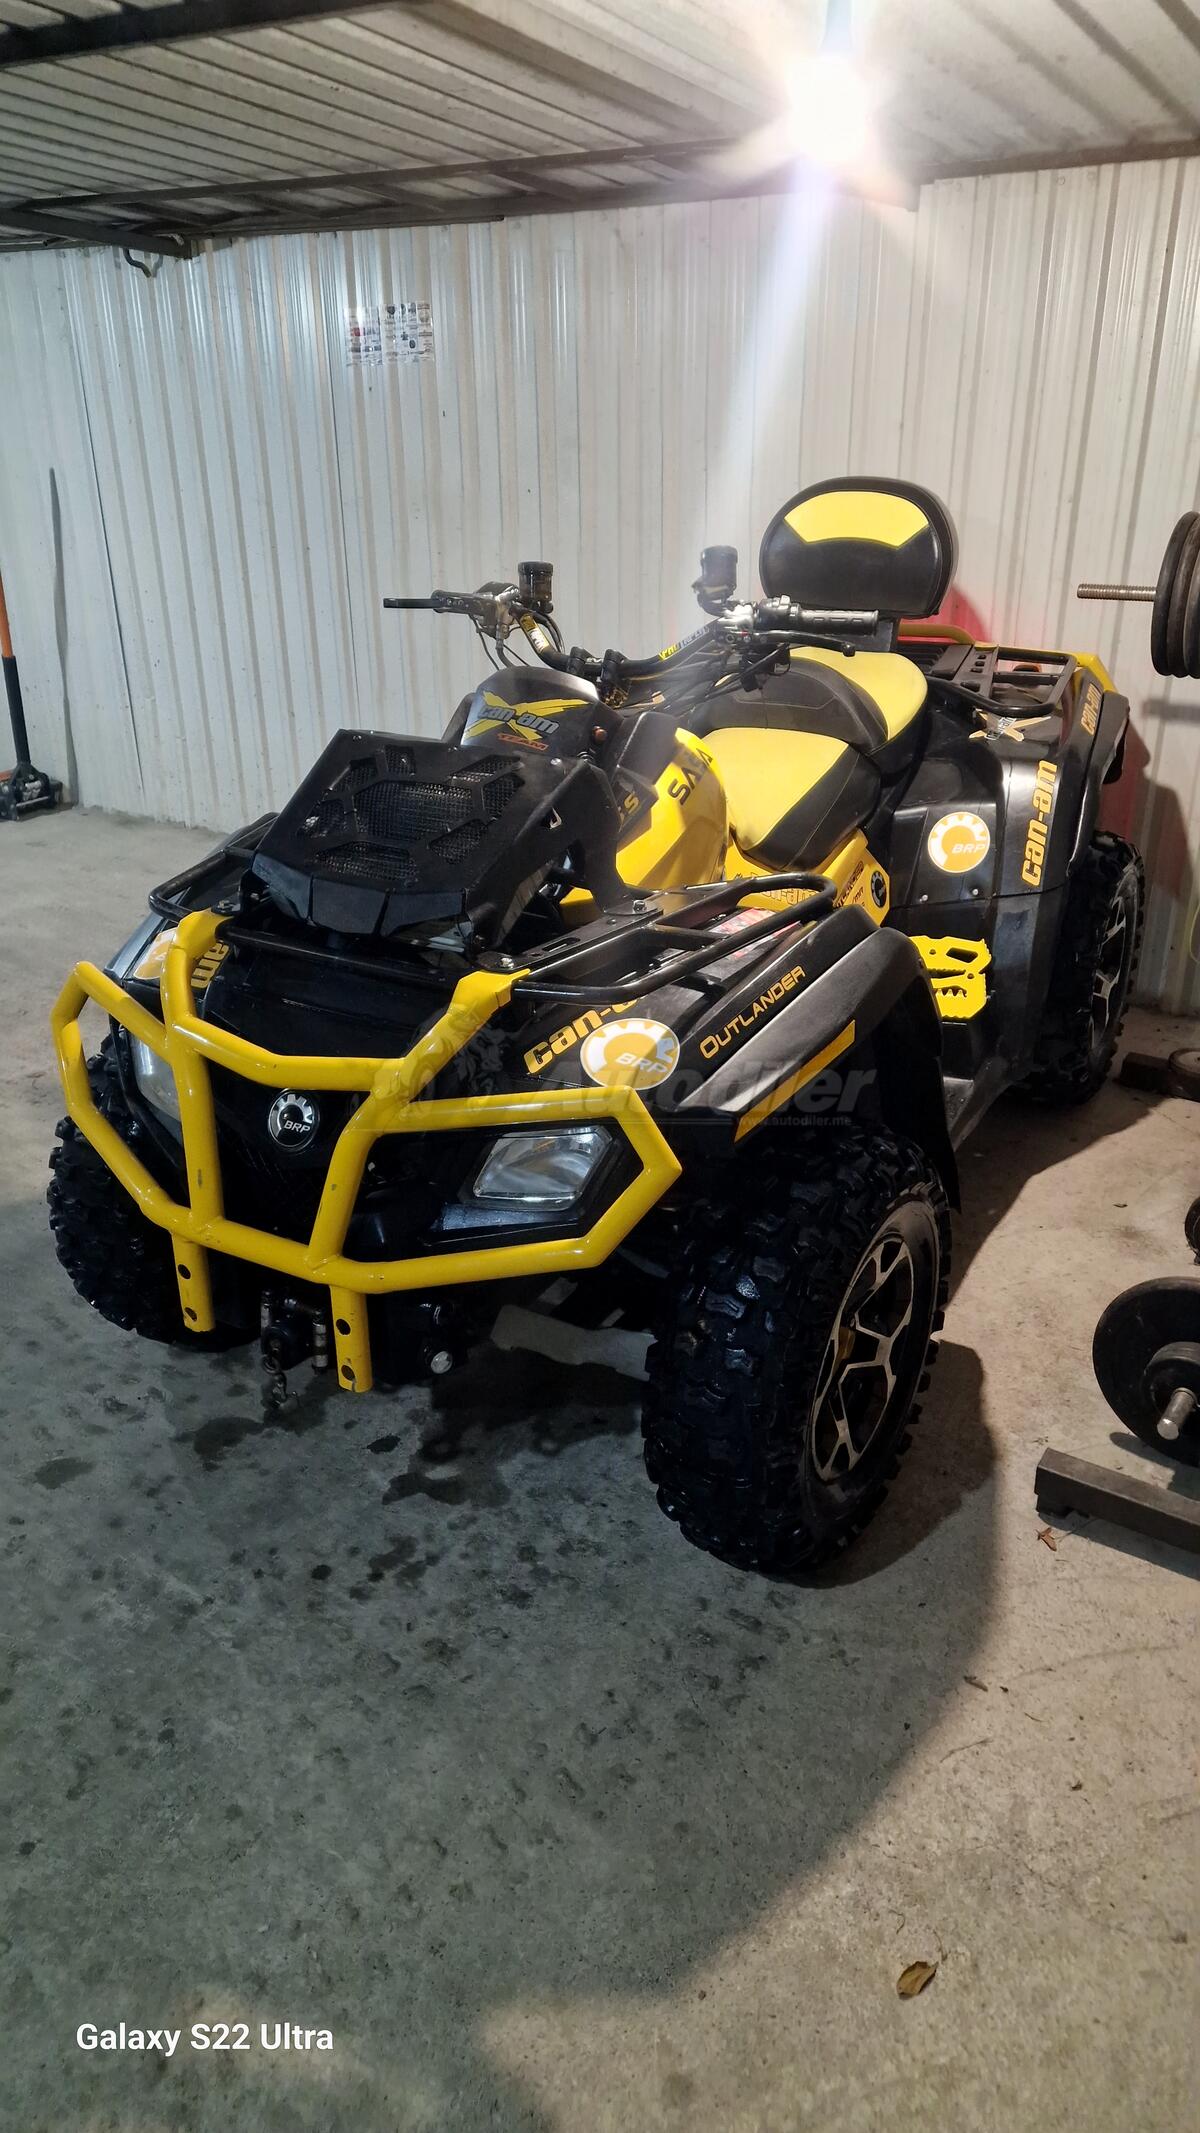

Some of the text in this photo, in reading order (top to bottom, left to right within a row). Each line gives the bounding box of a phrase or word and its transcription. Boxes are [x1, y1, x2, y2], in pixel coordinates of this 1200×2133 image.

[477, 704, 560, 734] can-am
[1021, 759, 1058, 886] can-am
[951, 842, 986, 855] BRP
[699, 965, 806, 1060] OUTLANDER
[615, 1052, 668, 1073] BRP
[283, 1120, 311, 1133] BRP
